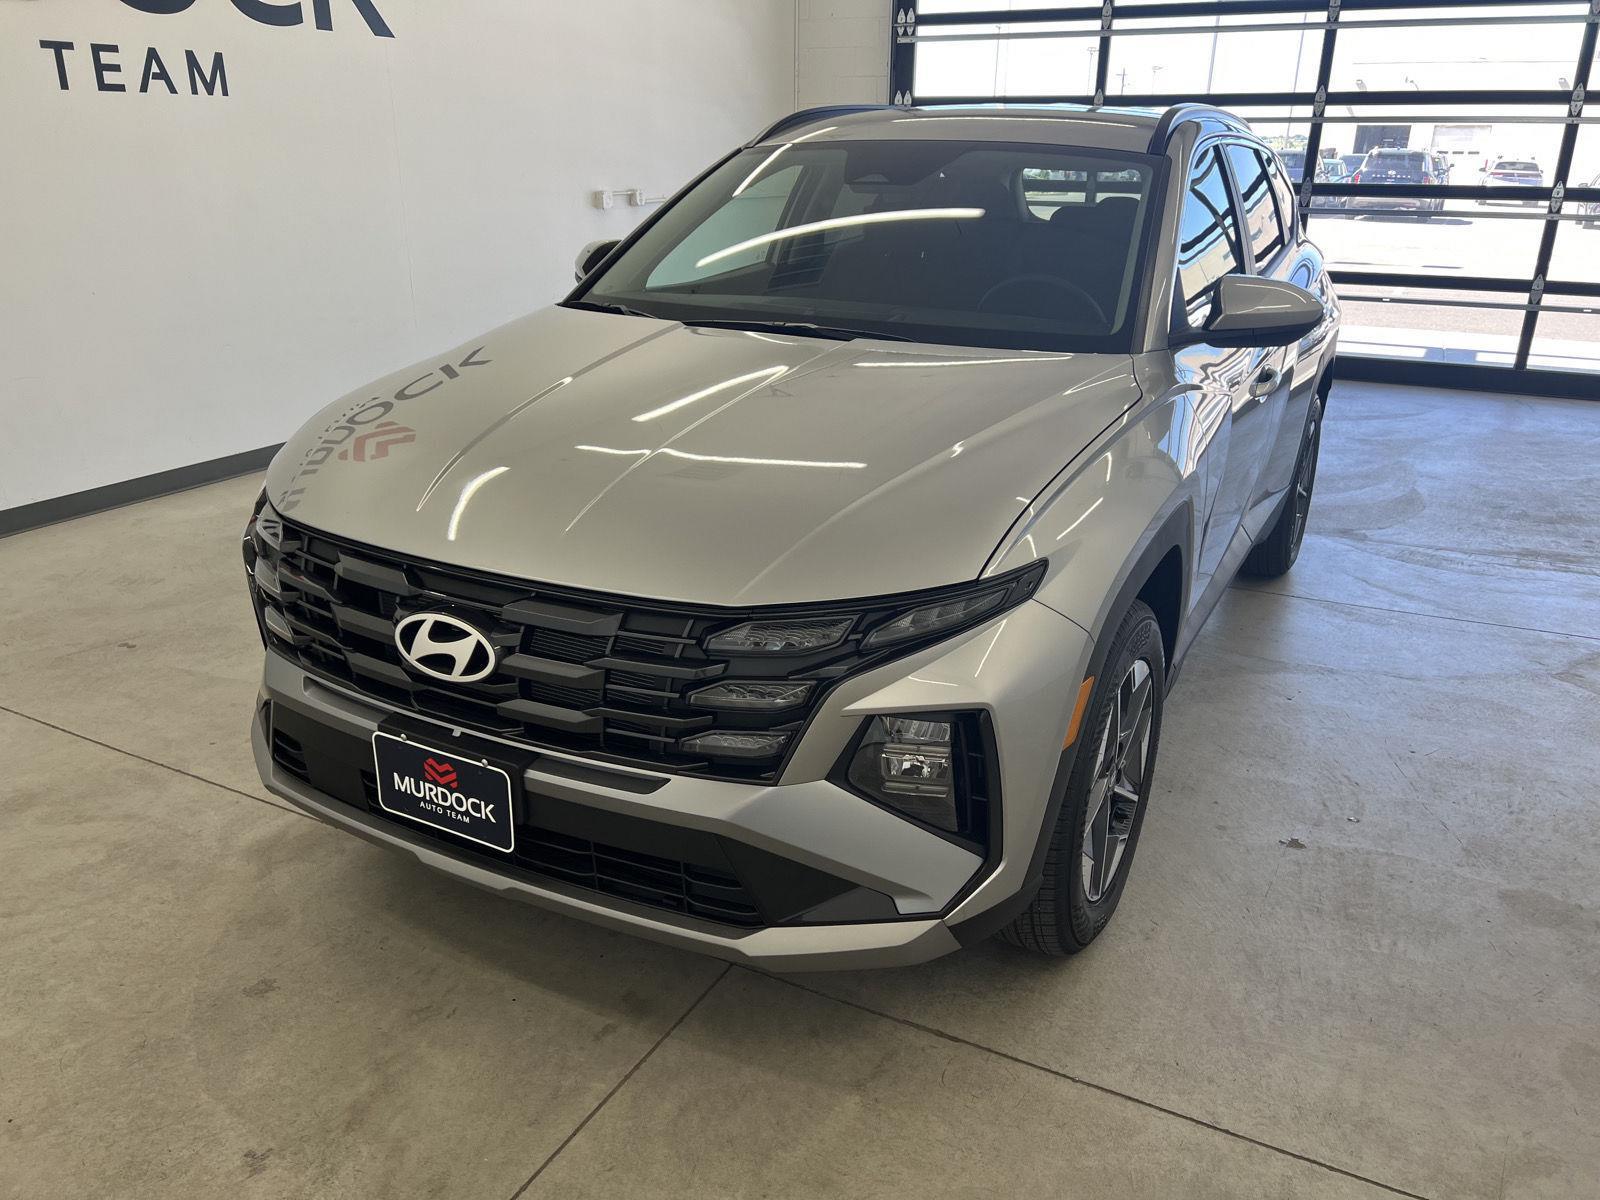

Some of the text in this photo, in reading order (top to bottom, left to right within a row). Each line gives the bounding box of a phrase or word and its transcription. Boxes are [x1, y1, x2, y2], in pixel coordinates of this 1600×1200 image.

[39, 39, 229, 97] TEAM
[393, 772, 497, 823] MURDOCK
[419, 801, 470, 824] AUTO TEAM
